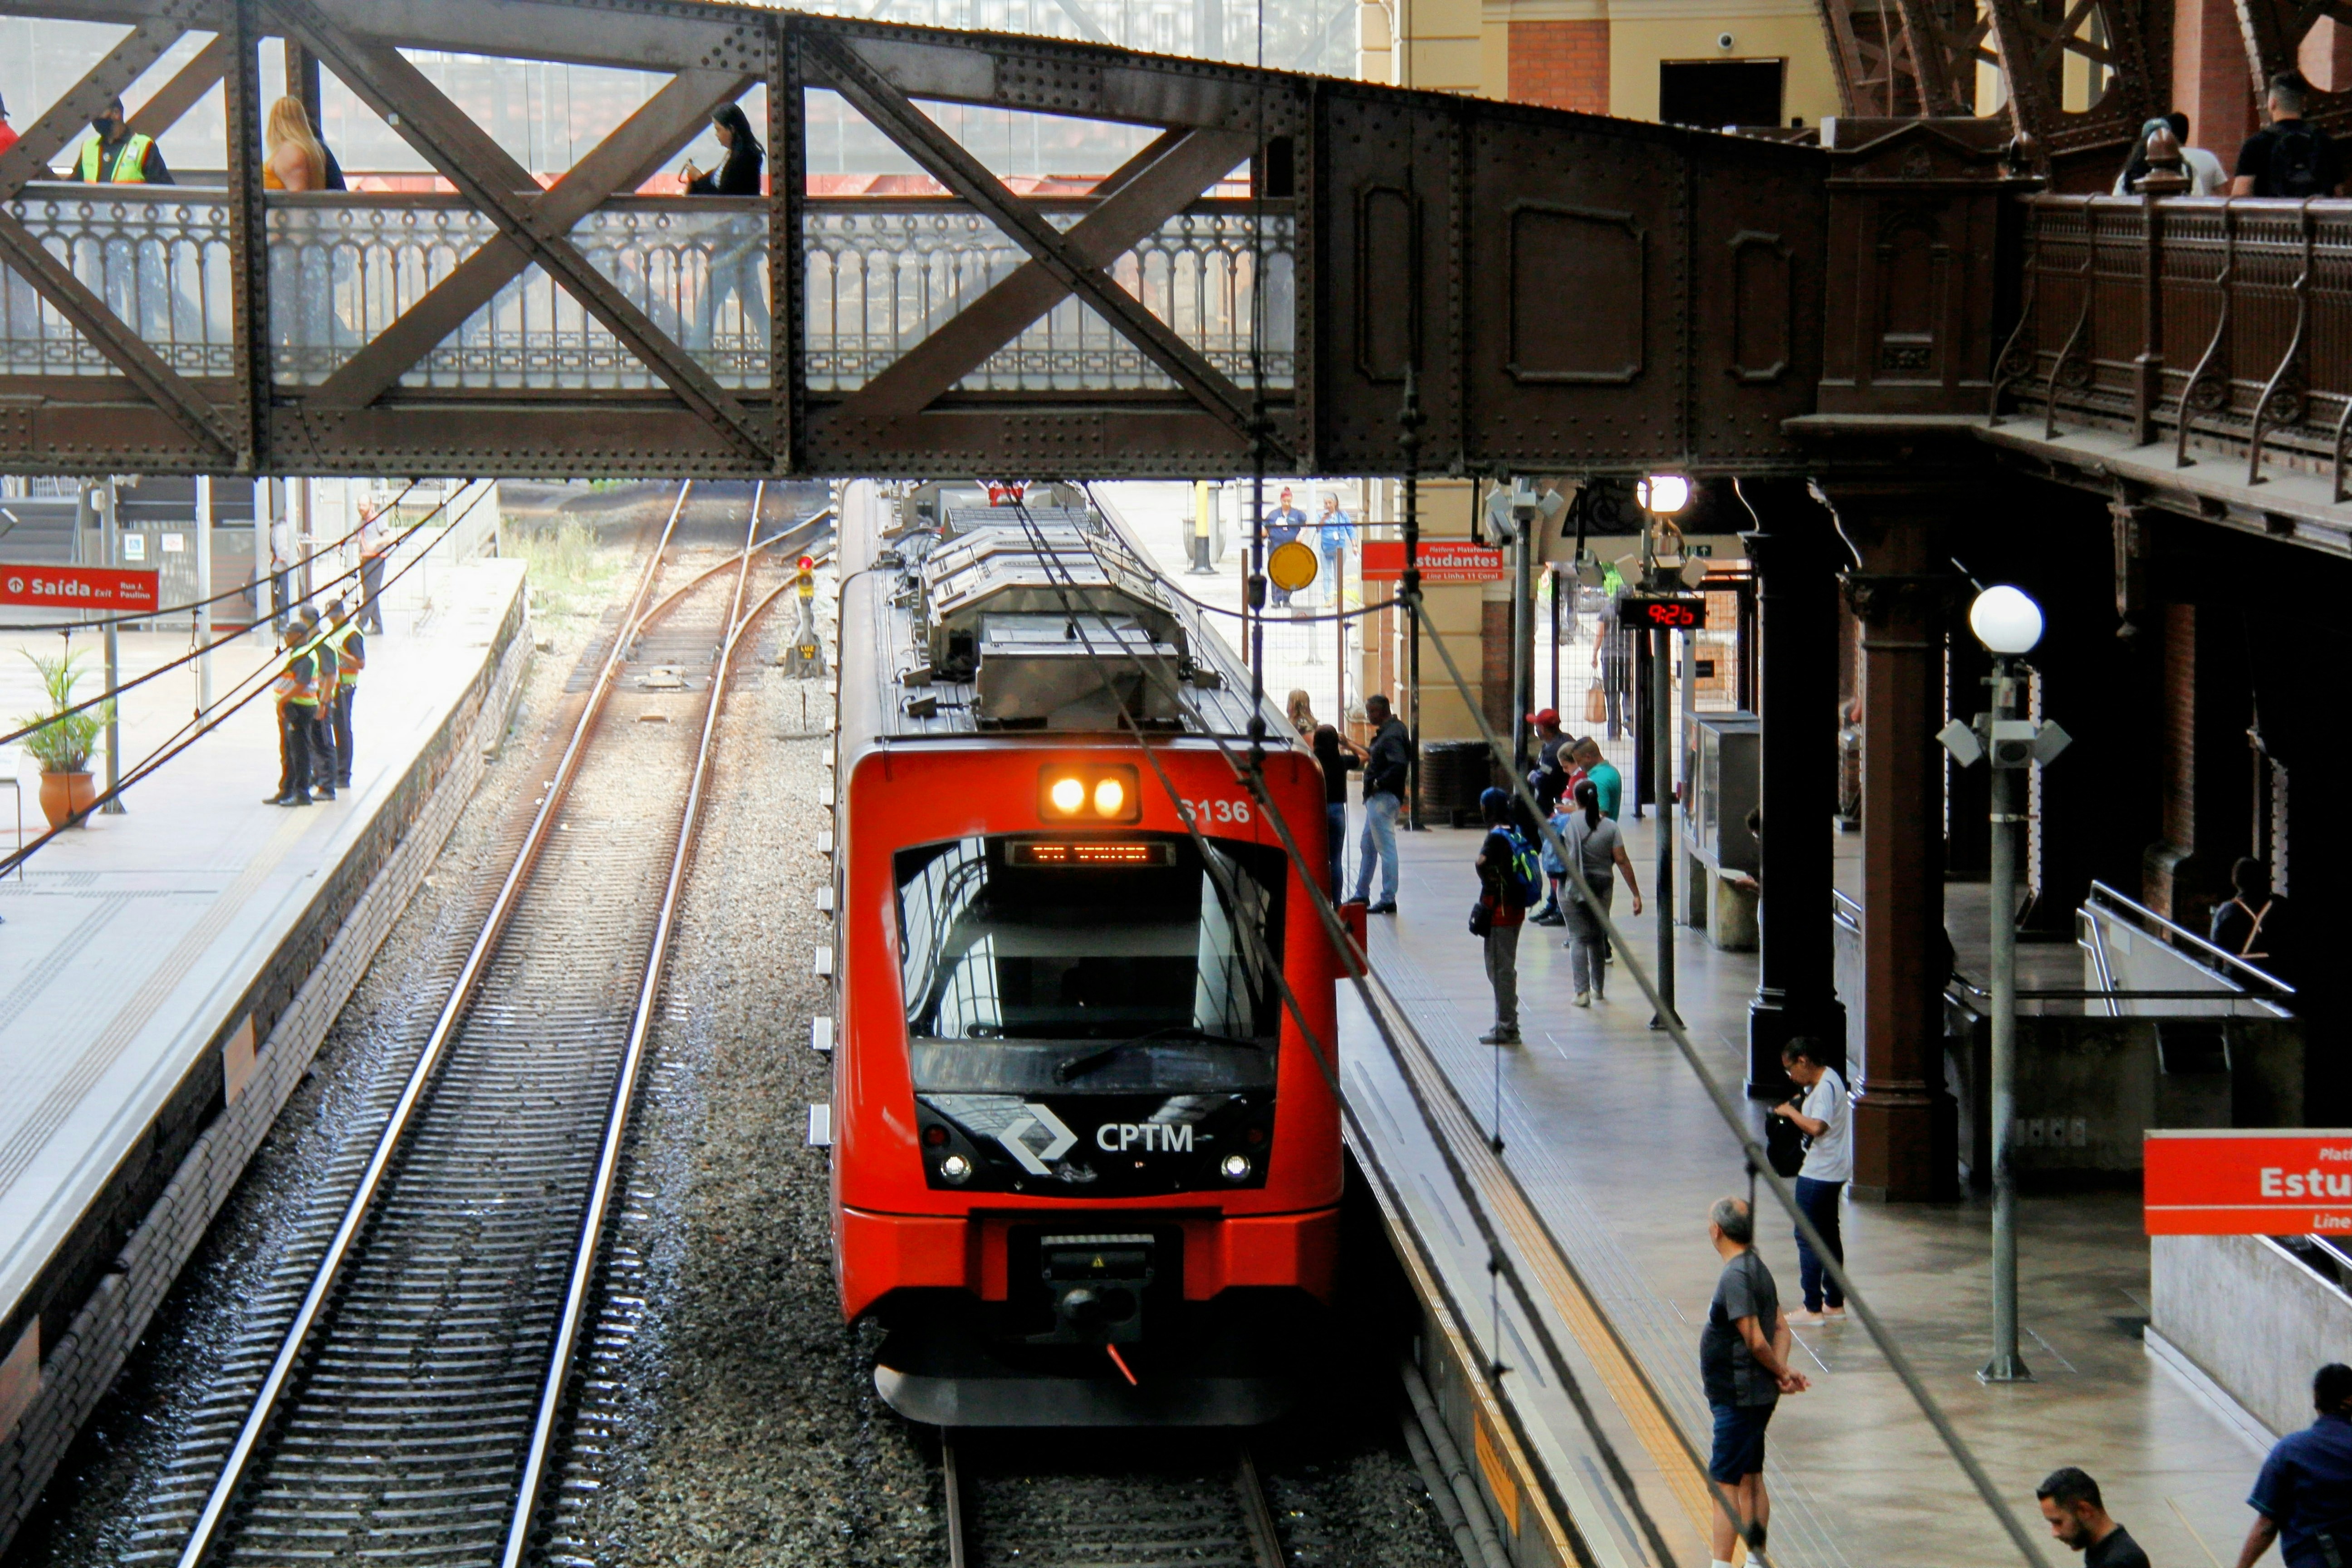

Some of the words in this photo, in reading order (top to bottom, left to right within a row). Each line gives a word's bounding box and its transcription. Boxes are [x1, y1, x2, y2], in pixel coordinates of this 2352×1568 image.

[1413, 554, 1498, 567] studantes
[32, 578, 90, 597] Saída
[94, 588, 112, 598] Exit
[120, 582, 135, 590] Rua
[120, 590, 151, 599] Paulino
[1648, 604, 1693, 624] 9:26
[1097, 1123, 1192, 1152] CPTM
[2313, 1213, 2351, 1229] Line
